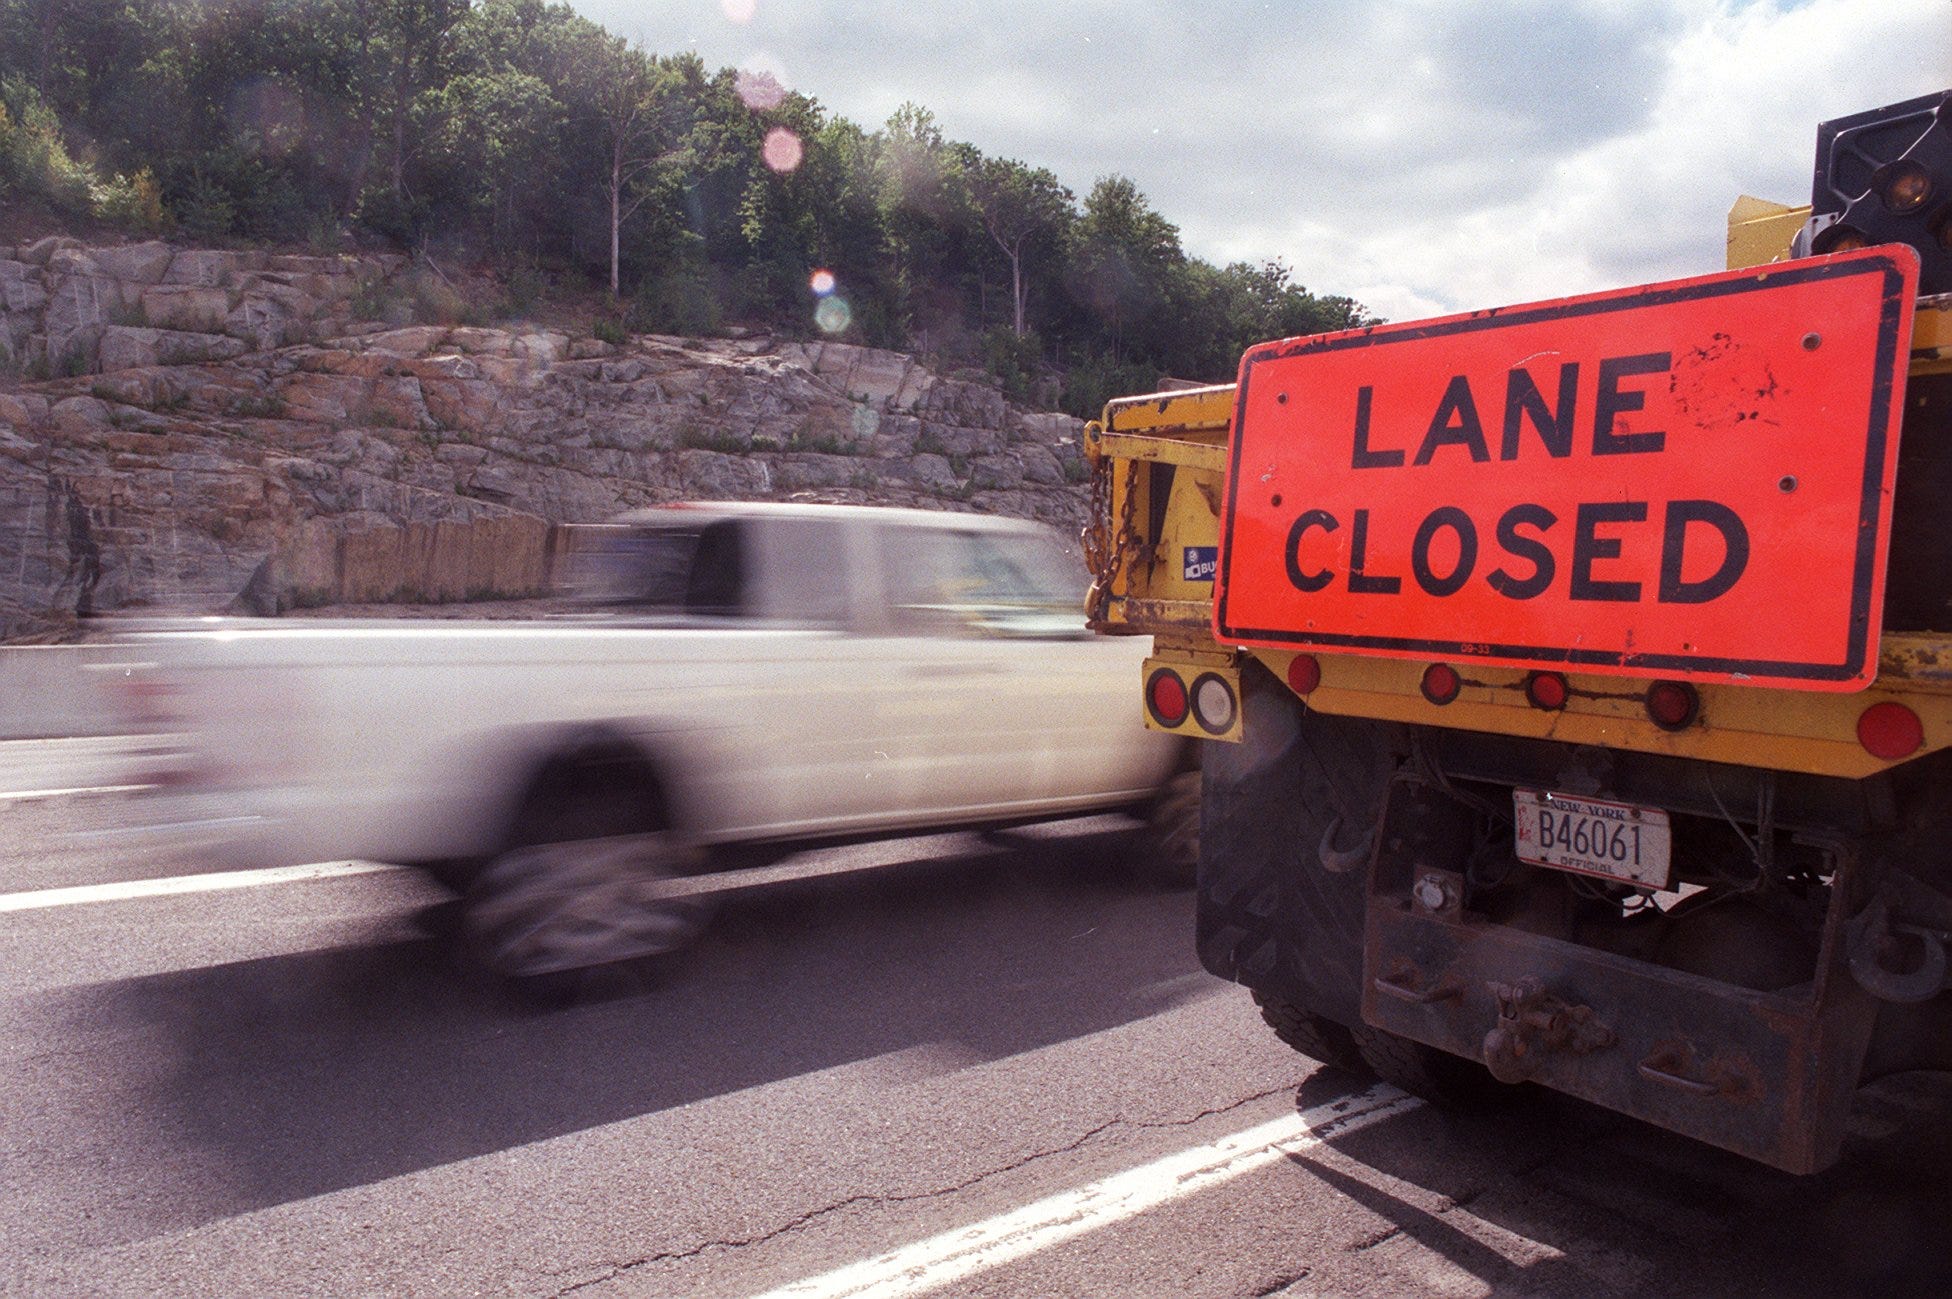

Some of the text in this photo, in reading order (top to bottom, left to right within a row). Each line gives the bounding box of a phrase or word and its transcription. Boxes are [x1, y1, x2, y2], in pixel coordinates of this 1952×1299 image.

[1351, 351, 1672, 470] LANE
[1201, 560, 1218, 574] BU
[1285, 499, 1751, 604] CLOSED
[1551, 800, 1625, 820] NEW YORK
[1539, 810, 1640, 865] B46061
[1560, 857, 1614, 874] OFFICIAL
